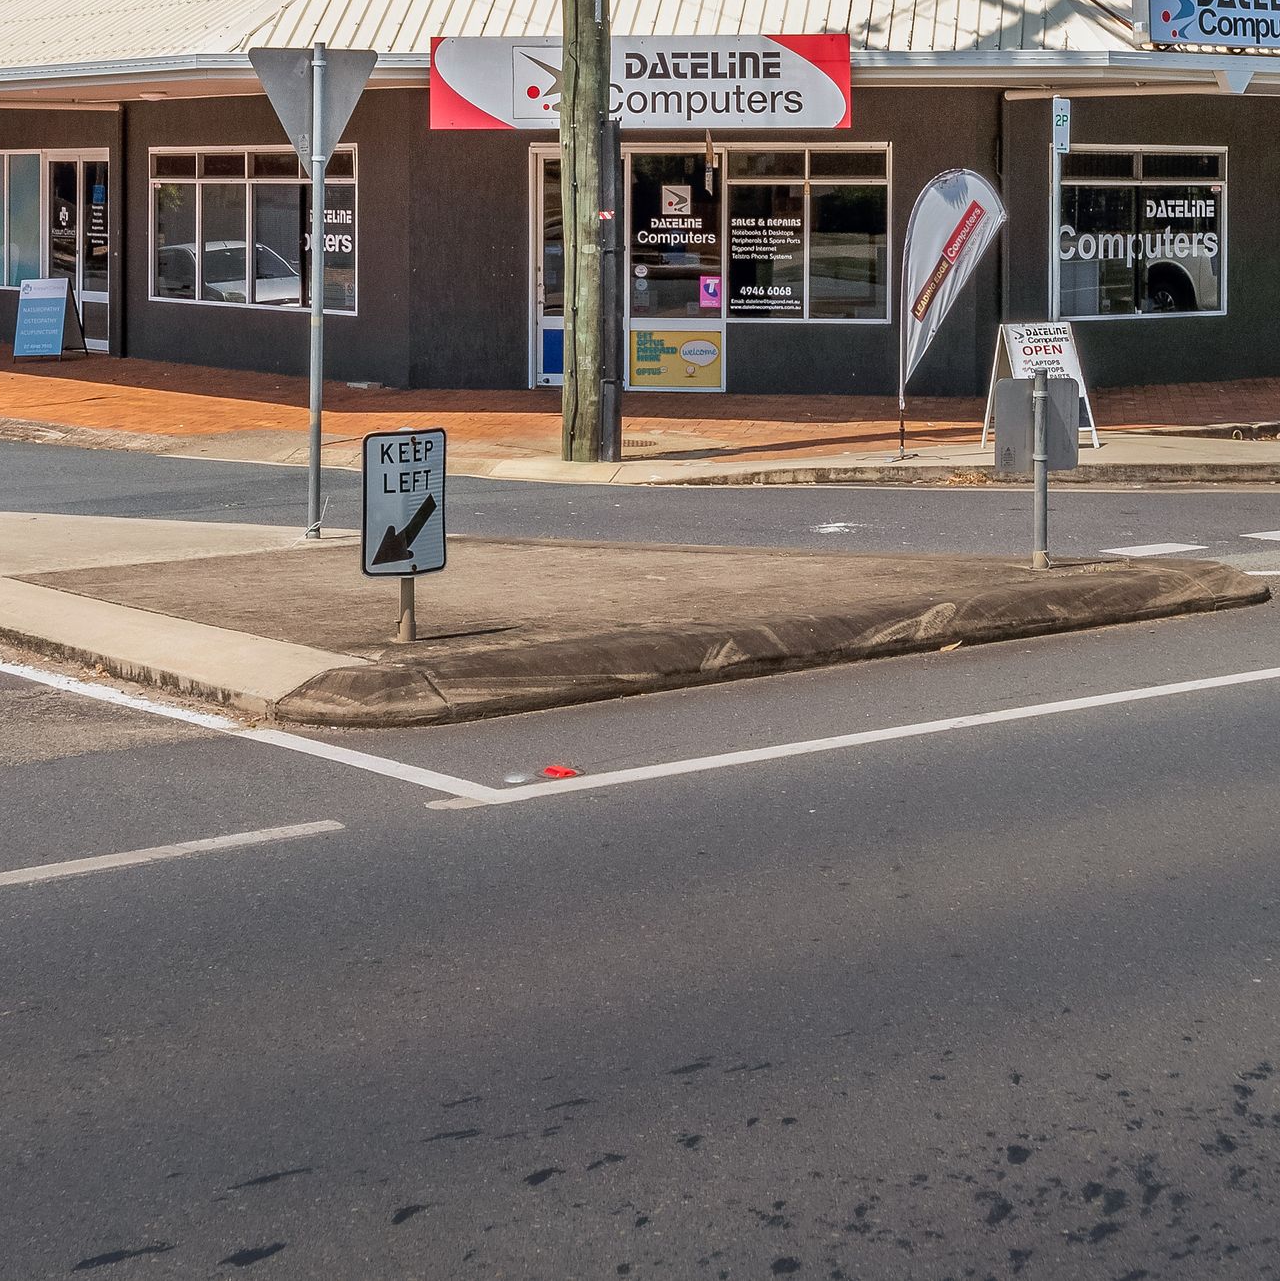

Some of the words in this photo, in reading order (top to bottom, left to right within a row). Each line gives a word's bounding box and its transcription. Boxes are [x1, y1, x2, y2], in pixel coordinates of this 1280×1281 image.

[625, 52, 781, 80] DATELINE
[1055, 114, 1069, 127] 2P
[1146, 200, 1215, 218] DATELINE
[651, 218, 702, 229] DATELINE
[731, 218, 756, 227] SALES
[758, 218, 765, 227] &
[637, 230, 716, 246] Computers
[768, 229, 794, 237] Desktops
[946, 207, 981, 258] Computers
[769, 237, 785, 245] Spare
[1060, 224, 1219, 268] Computers
[732, 245, 754, 253] Bigpond
[740, 286, 765, 296] 4946
[767, 286, 792, 296] 6068
[915, 281, 937, 317] LEADING
[934, 261, 949, 285] EDGE
[1028, 335, 1070, 345] Computers
[681, 348, 718, 356] welcome
[1022, 344, 1063, 356] OPEN
[1031, 359, 1061, 367] LAPTOPS
[381, 440, 434, 465] KEEP
[384, 469, 432, 494] LEFT
